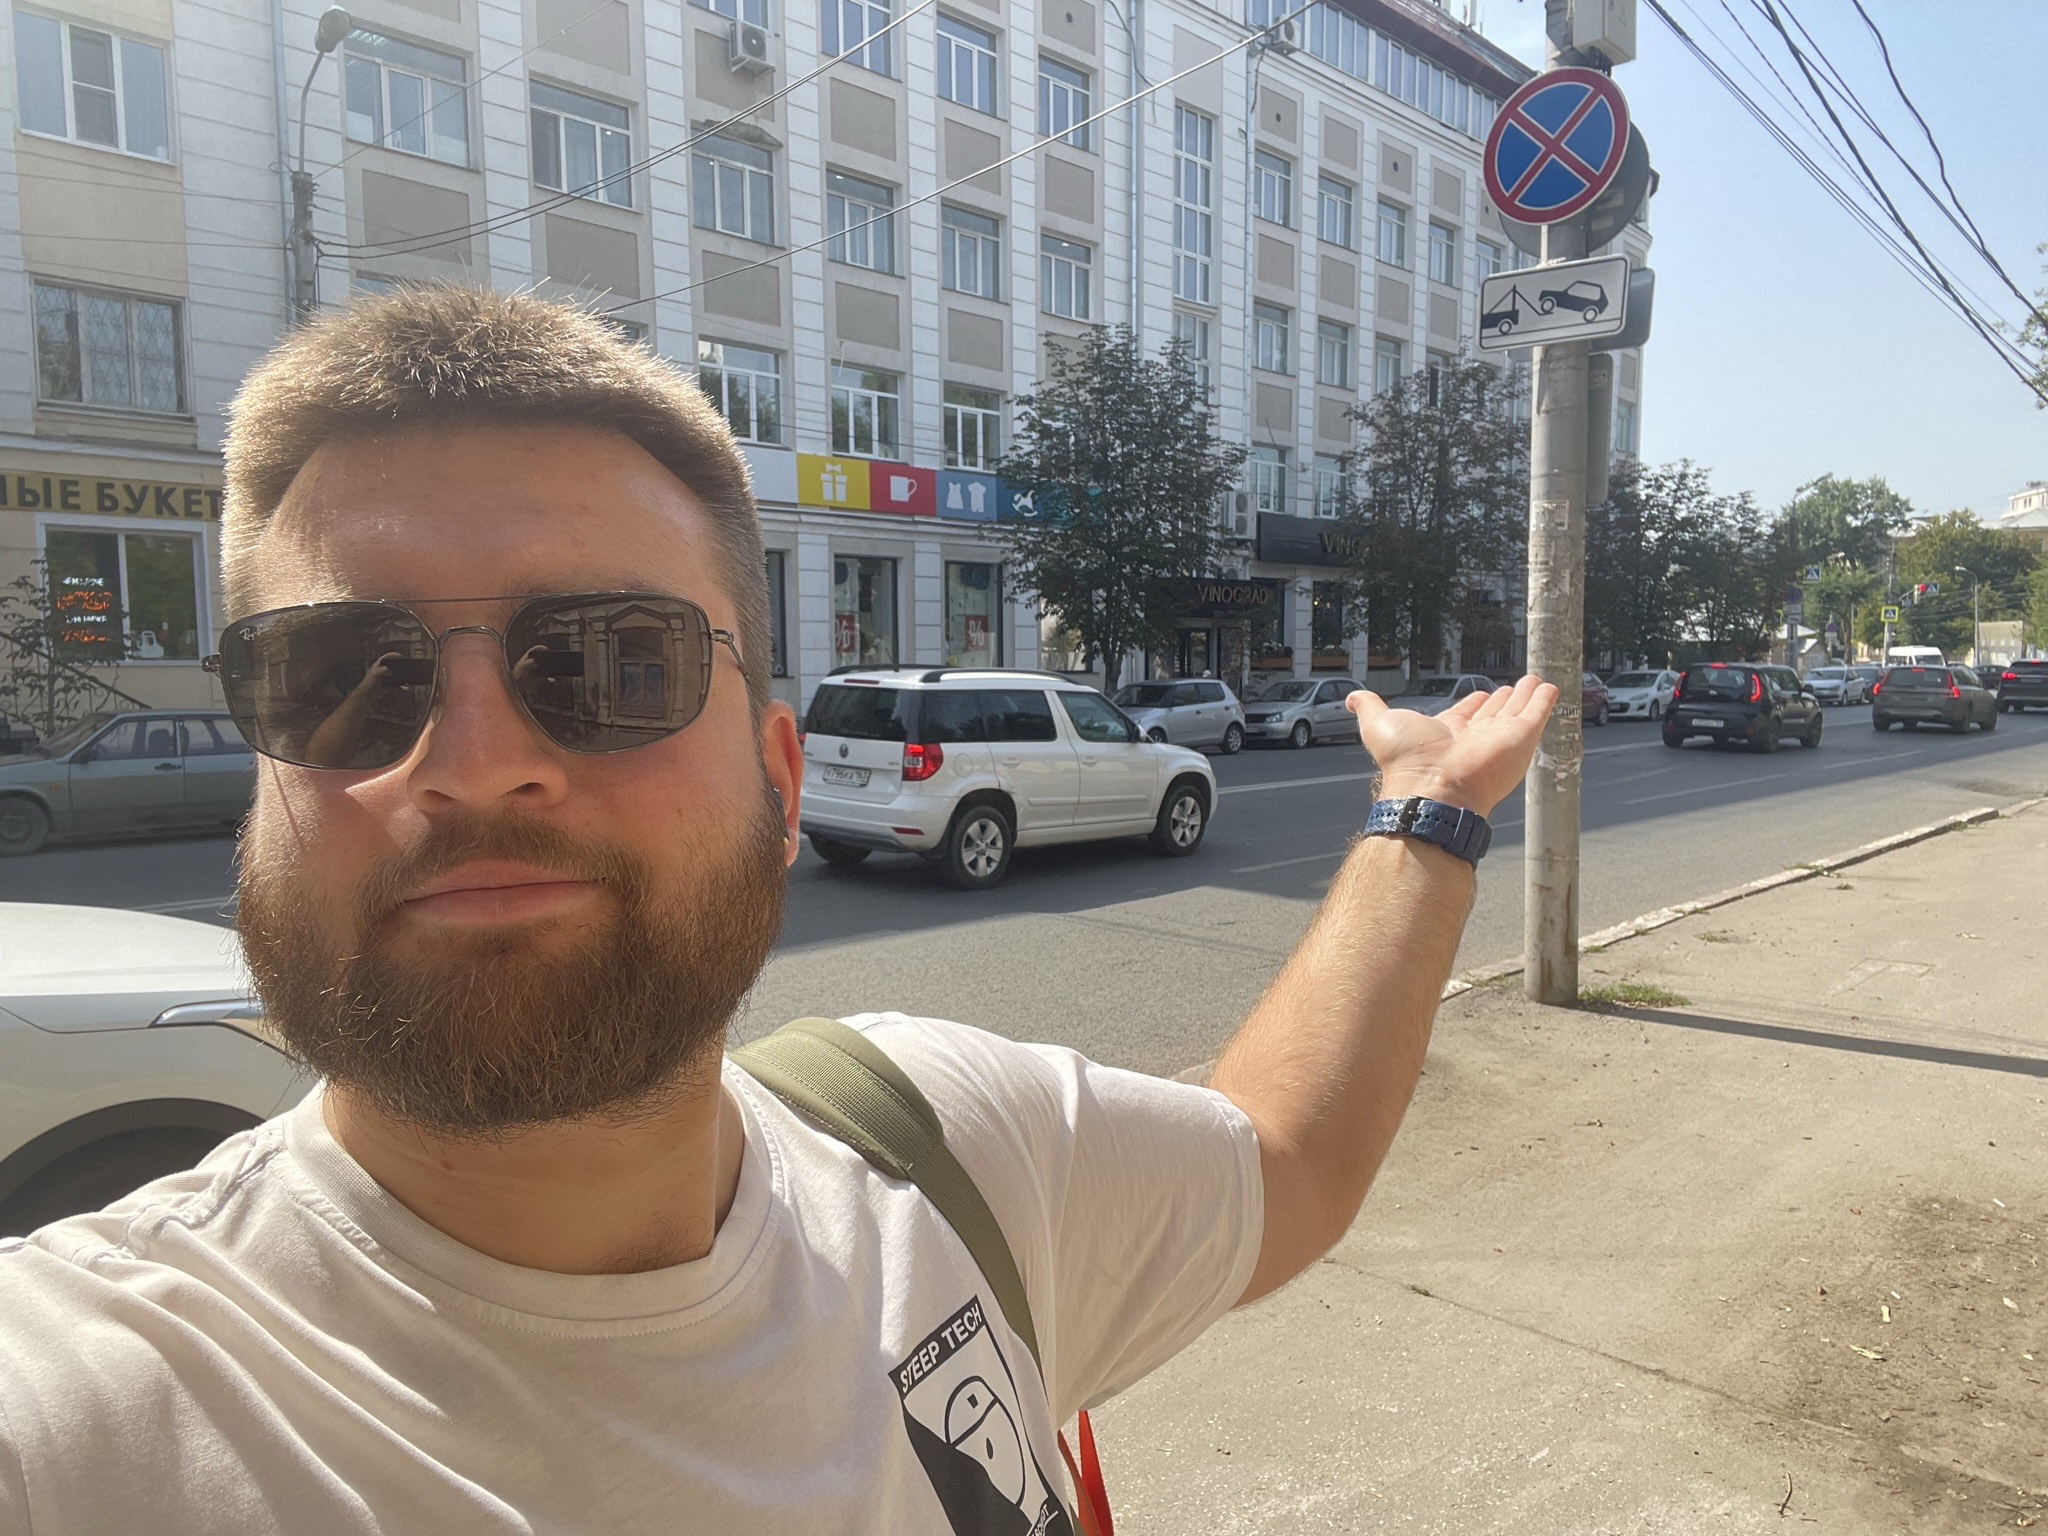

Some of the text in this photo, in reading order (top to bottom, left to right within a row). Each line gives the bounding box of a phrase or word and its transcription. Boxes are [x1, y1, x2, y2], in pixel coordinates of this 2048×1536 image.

[1197, 583, 1269, 605] VINOGRAD
[968, 619, 985, 647] %
[899, 1303, 983, 1394] STEEP TECH
